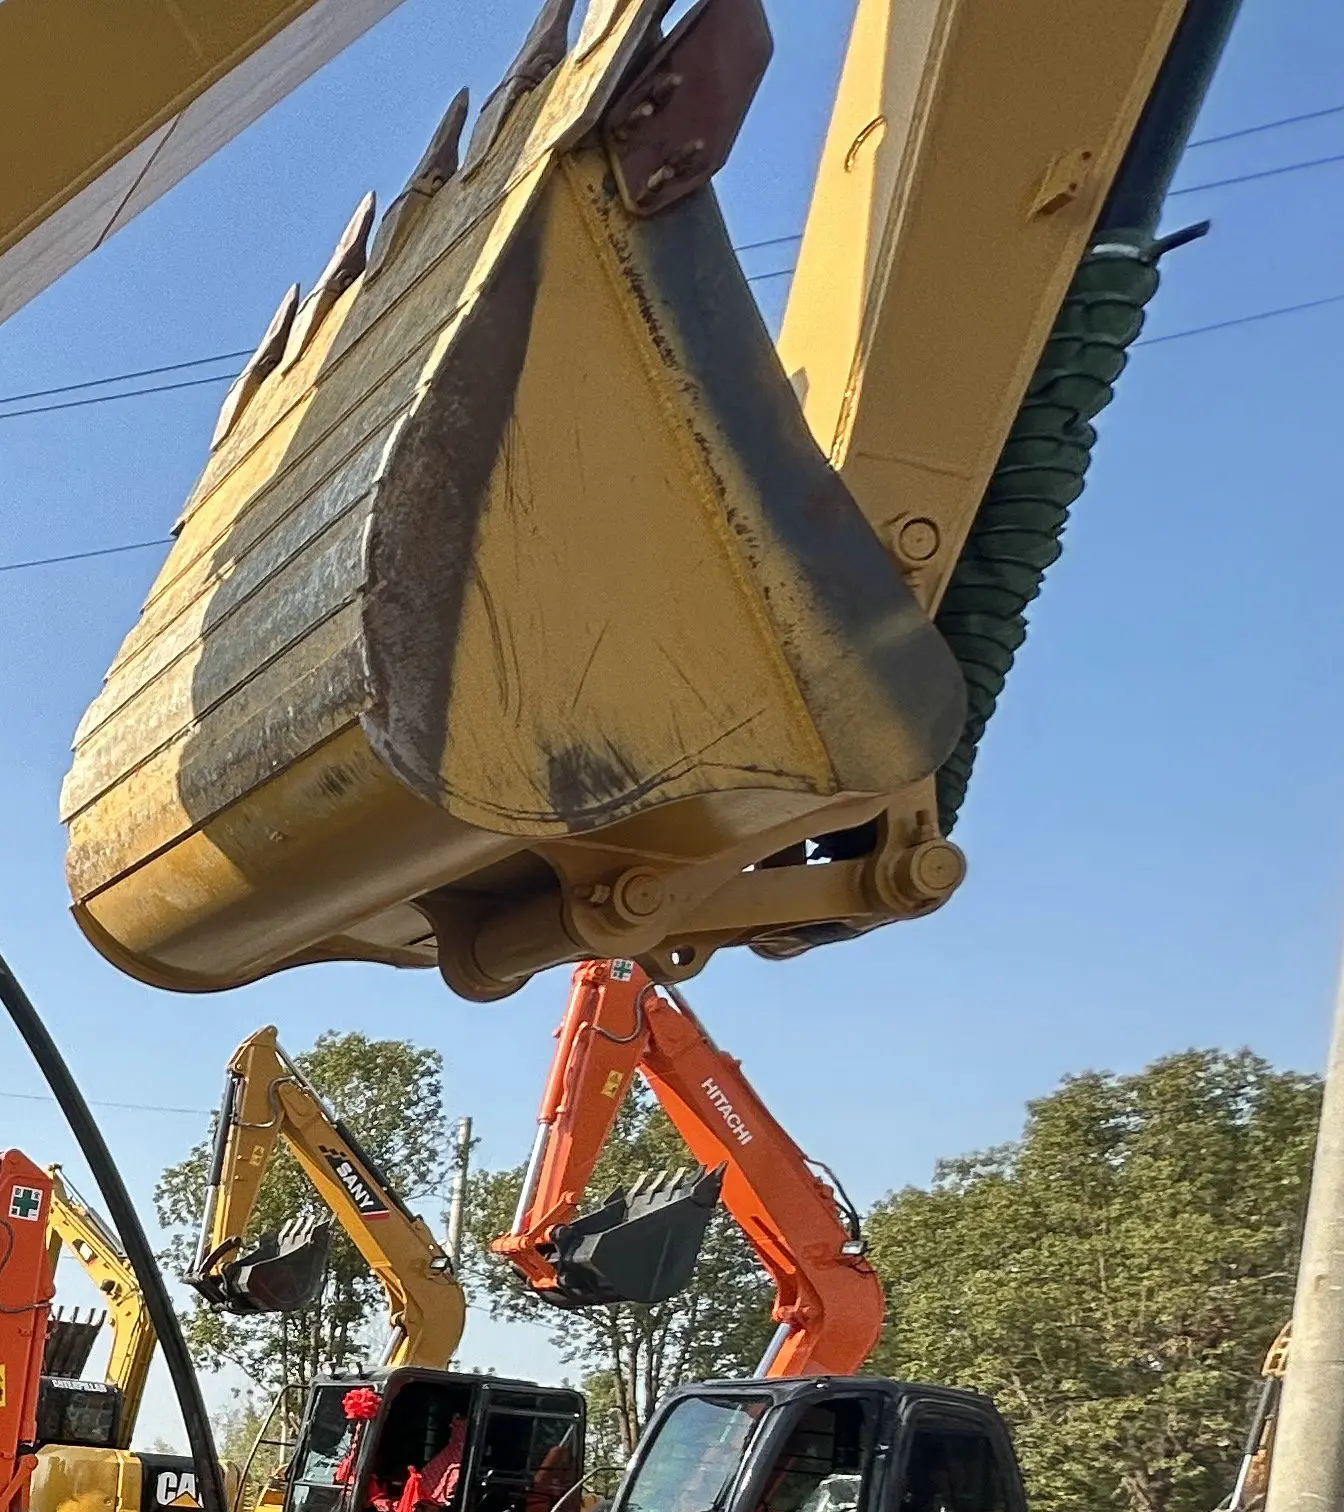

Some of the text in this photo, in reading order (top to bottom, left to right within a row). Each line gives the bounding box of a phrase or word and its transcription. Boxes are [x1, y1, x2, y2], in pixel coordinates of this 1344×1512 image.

[701, 1077, 753, 1145] HITACHI
[336, 1162, 374, 1208] SANY
[156, 1471, 205, 1509] CA
